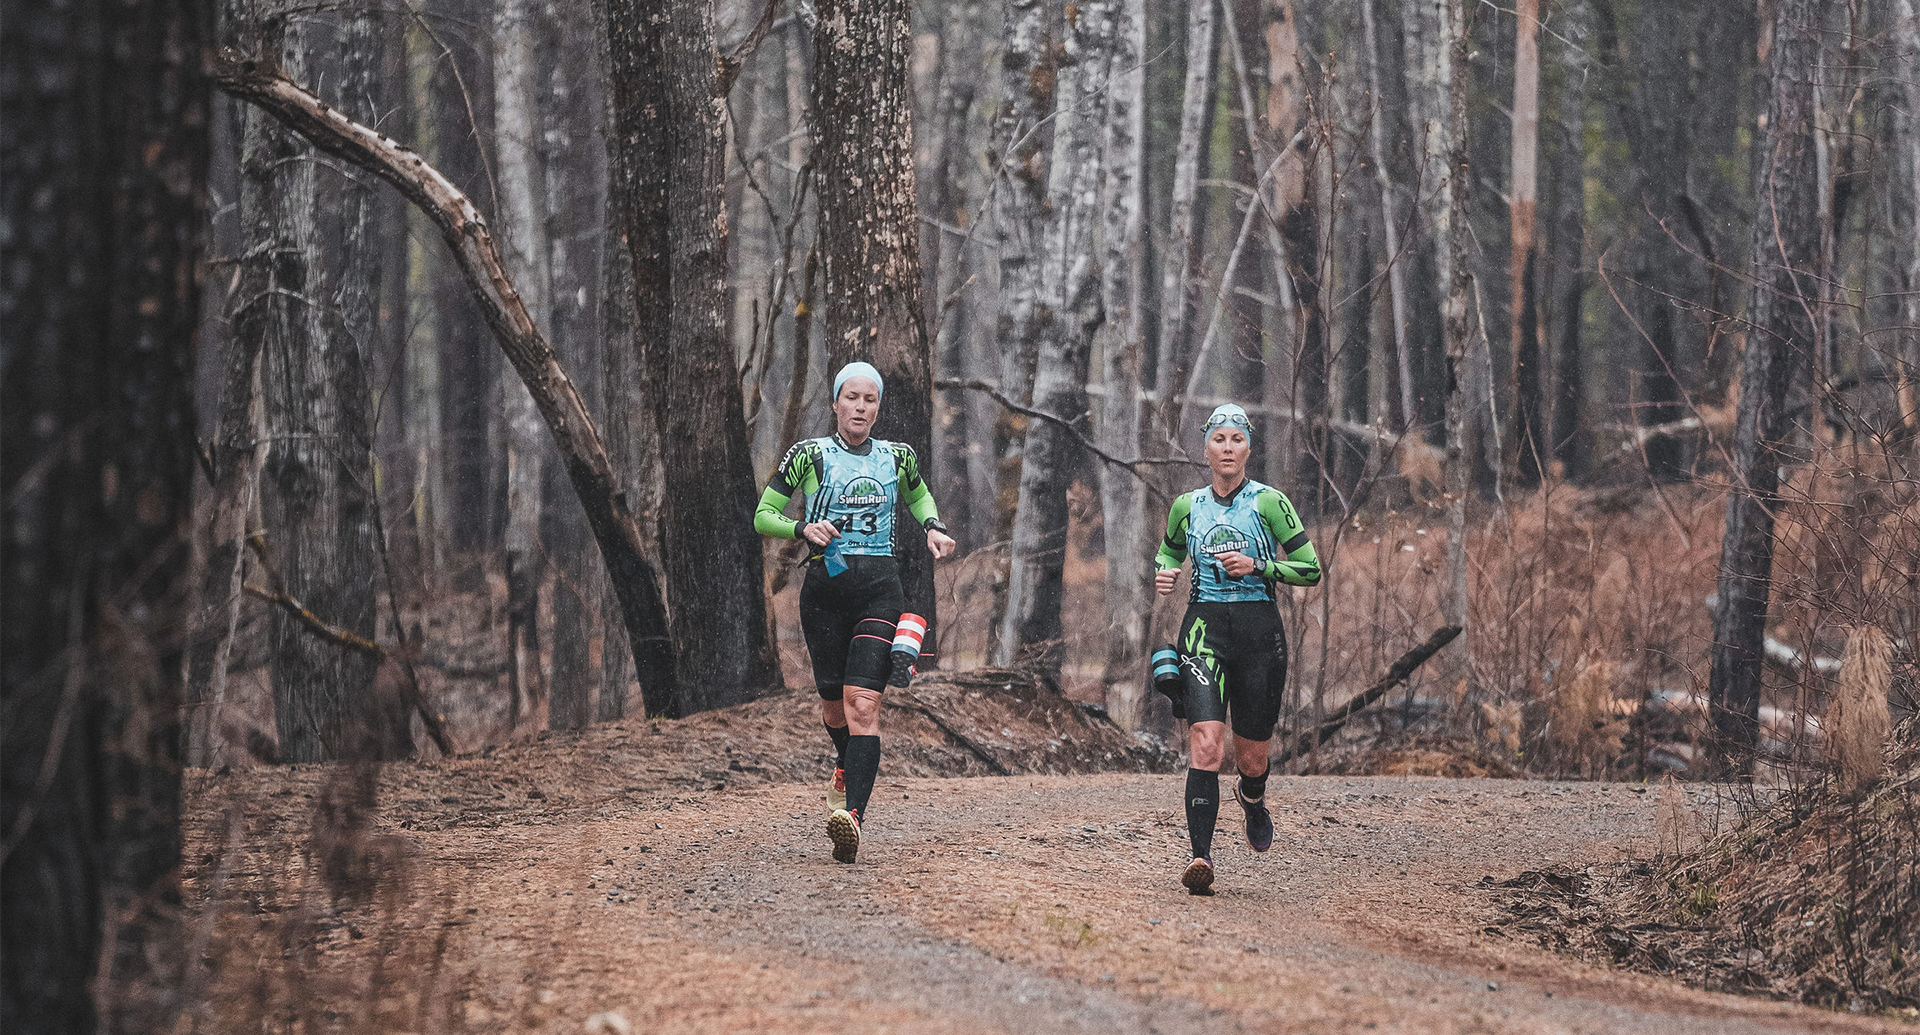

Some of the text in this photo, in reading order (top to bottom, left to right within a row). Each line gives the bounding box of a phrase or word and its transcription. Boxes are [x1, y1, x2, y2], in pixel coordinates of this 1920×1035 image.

[826, 446, 838, 454] 13
[838, 494, 888, 504] SwimRun
[1195, 495, 1206, 503] 13
[845, 512, 877, 536] 13
[1200, 540, 1249, 554] SwimRun
